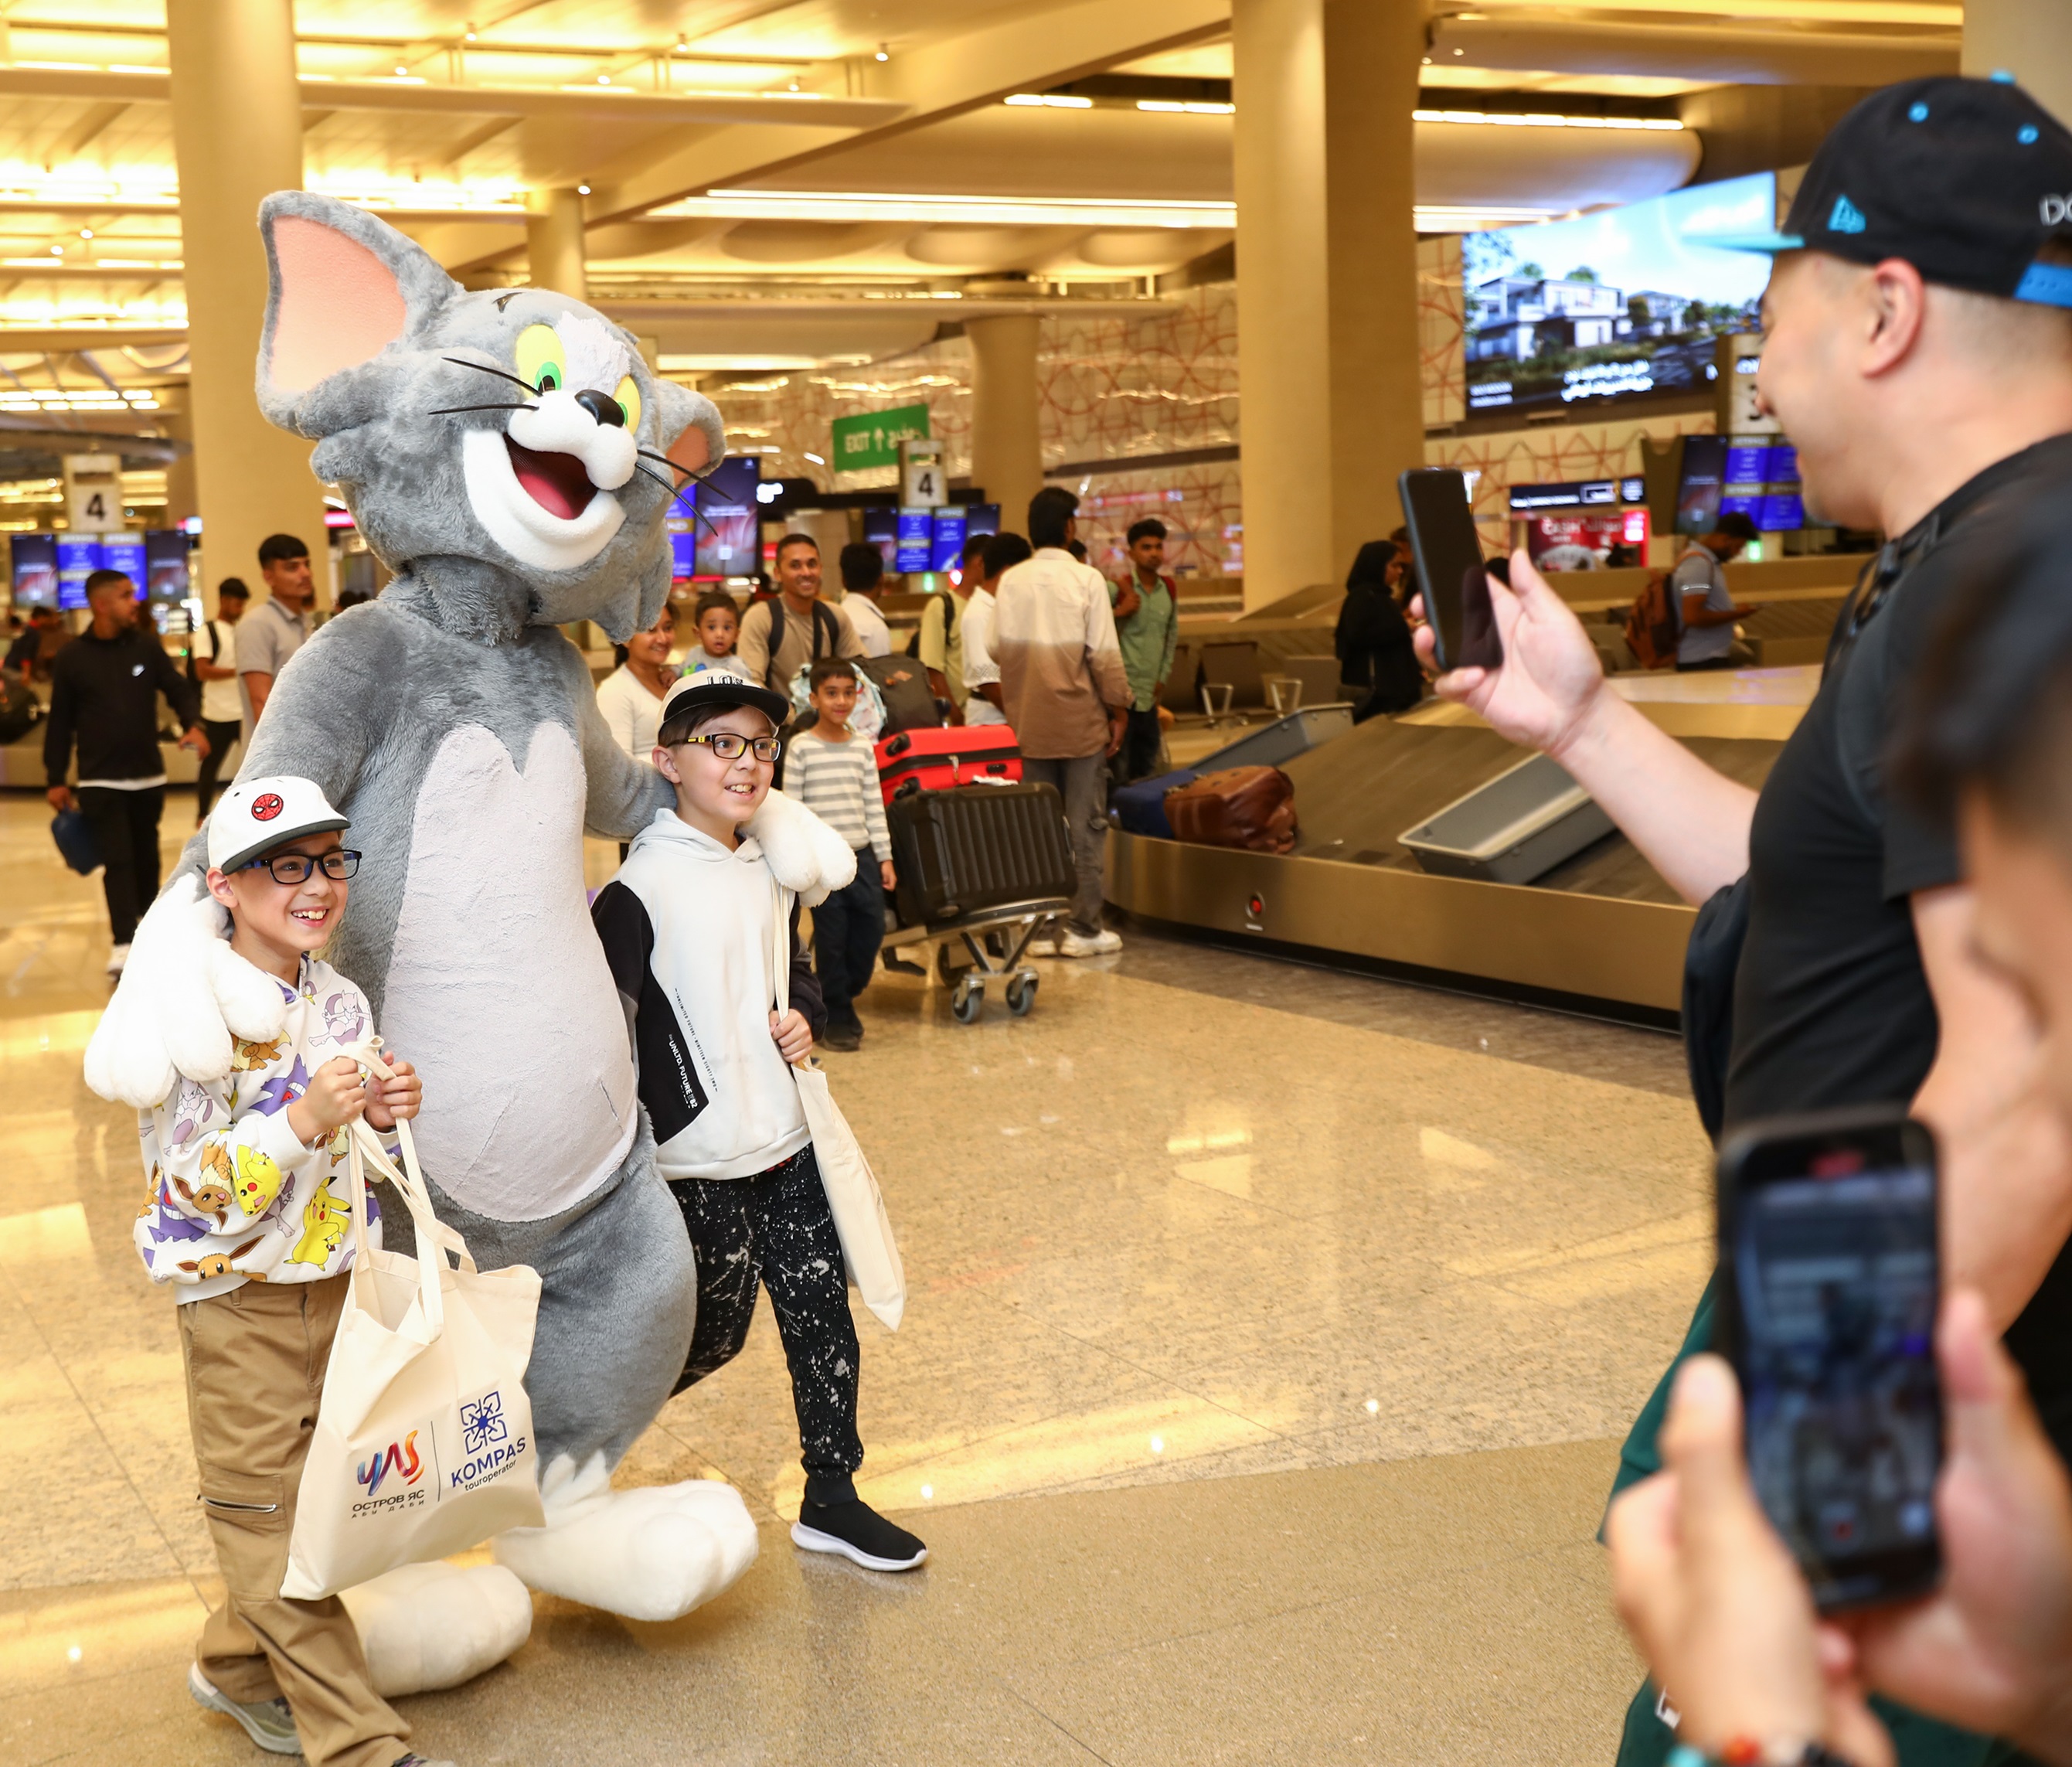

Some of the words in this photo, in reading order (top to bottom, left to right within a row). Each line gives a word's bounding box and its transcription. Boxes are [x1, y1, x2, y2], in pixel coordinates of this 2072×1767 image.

[845, 431, 869, 454] EXIT
[918, 472, 934, 497] 4
[86, 492, 105, 521] 4
[679, 1065, 692, 1095] FUTURE
[689, 1098, 698, 1109] 82
[451, 1436, 526, 1488] KOMPAS
[464, 1459, 517, 1492] touroperator
[352, 1494, 405, 1512] ОСТРОВ
[407, 1489, 425, 1502] ЯС
[352, 1510, 378, 1519] АБУ
[388, 1500, 425, 1513] ДАБИ
